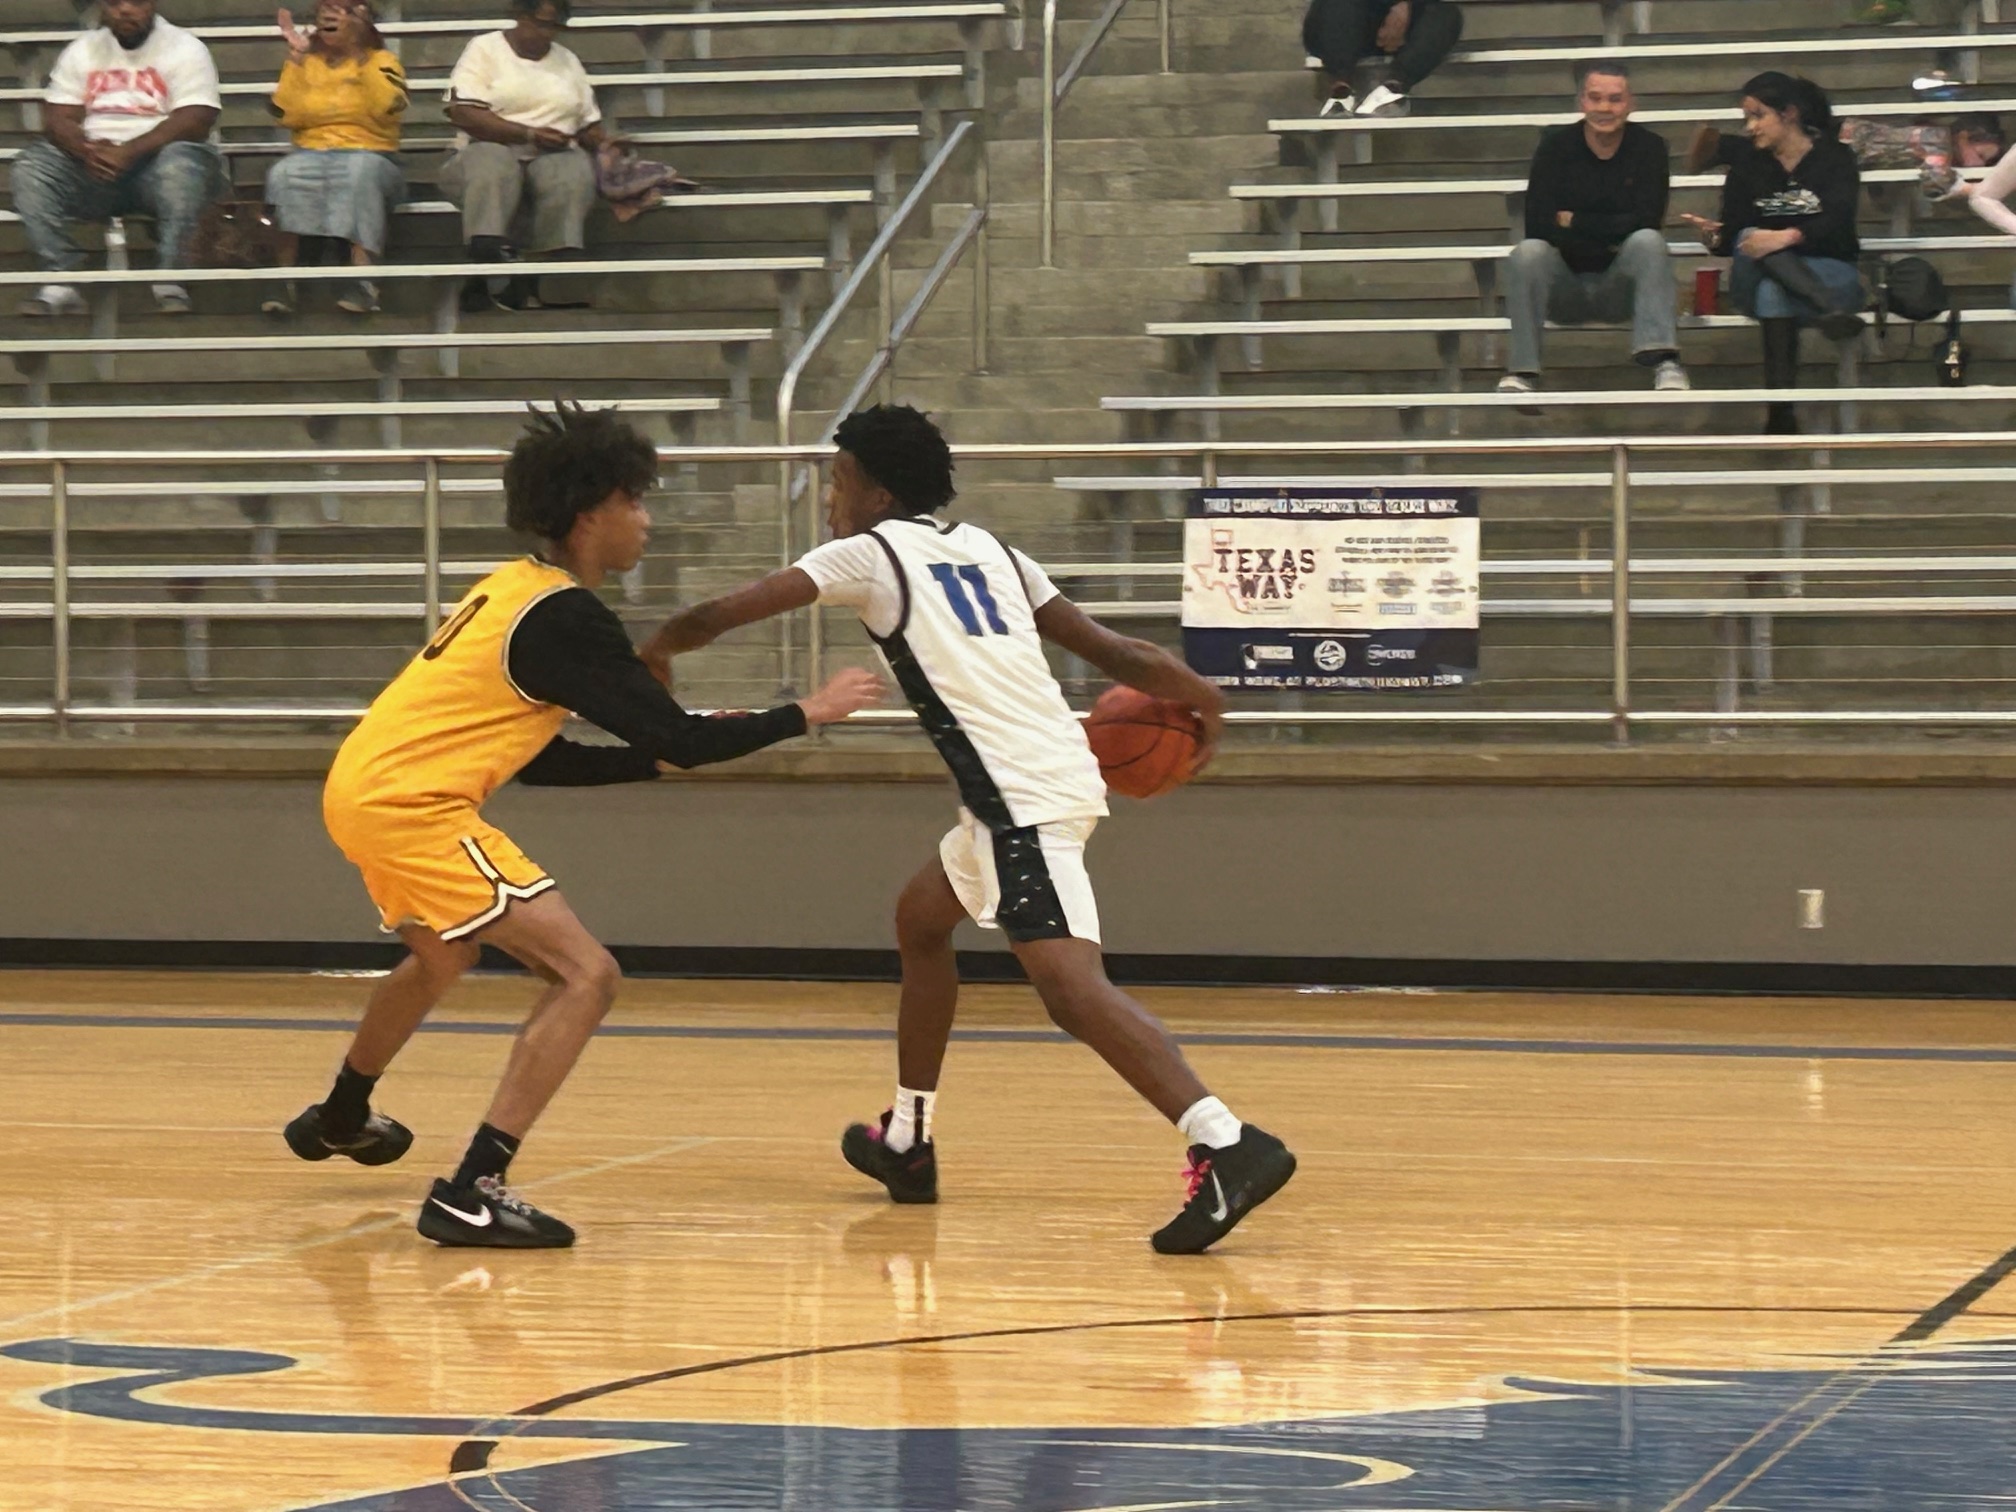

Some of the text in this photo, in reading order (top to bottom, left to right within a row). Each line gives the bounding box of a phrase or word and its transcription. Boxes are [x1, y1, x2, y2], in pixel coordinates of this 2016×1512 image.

[1213, 548, 1315, 573] TEXAS
[1235, 574, 1297, 599] WAY
[926, 562, 1009, 637] 11
